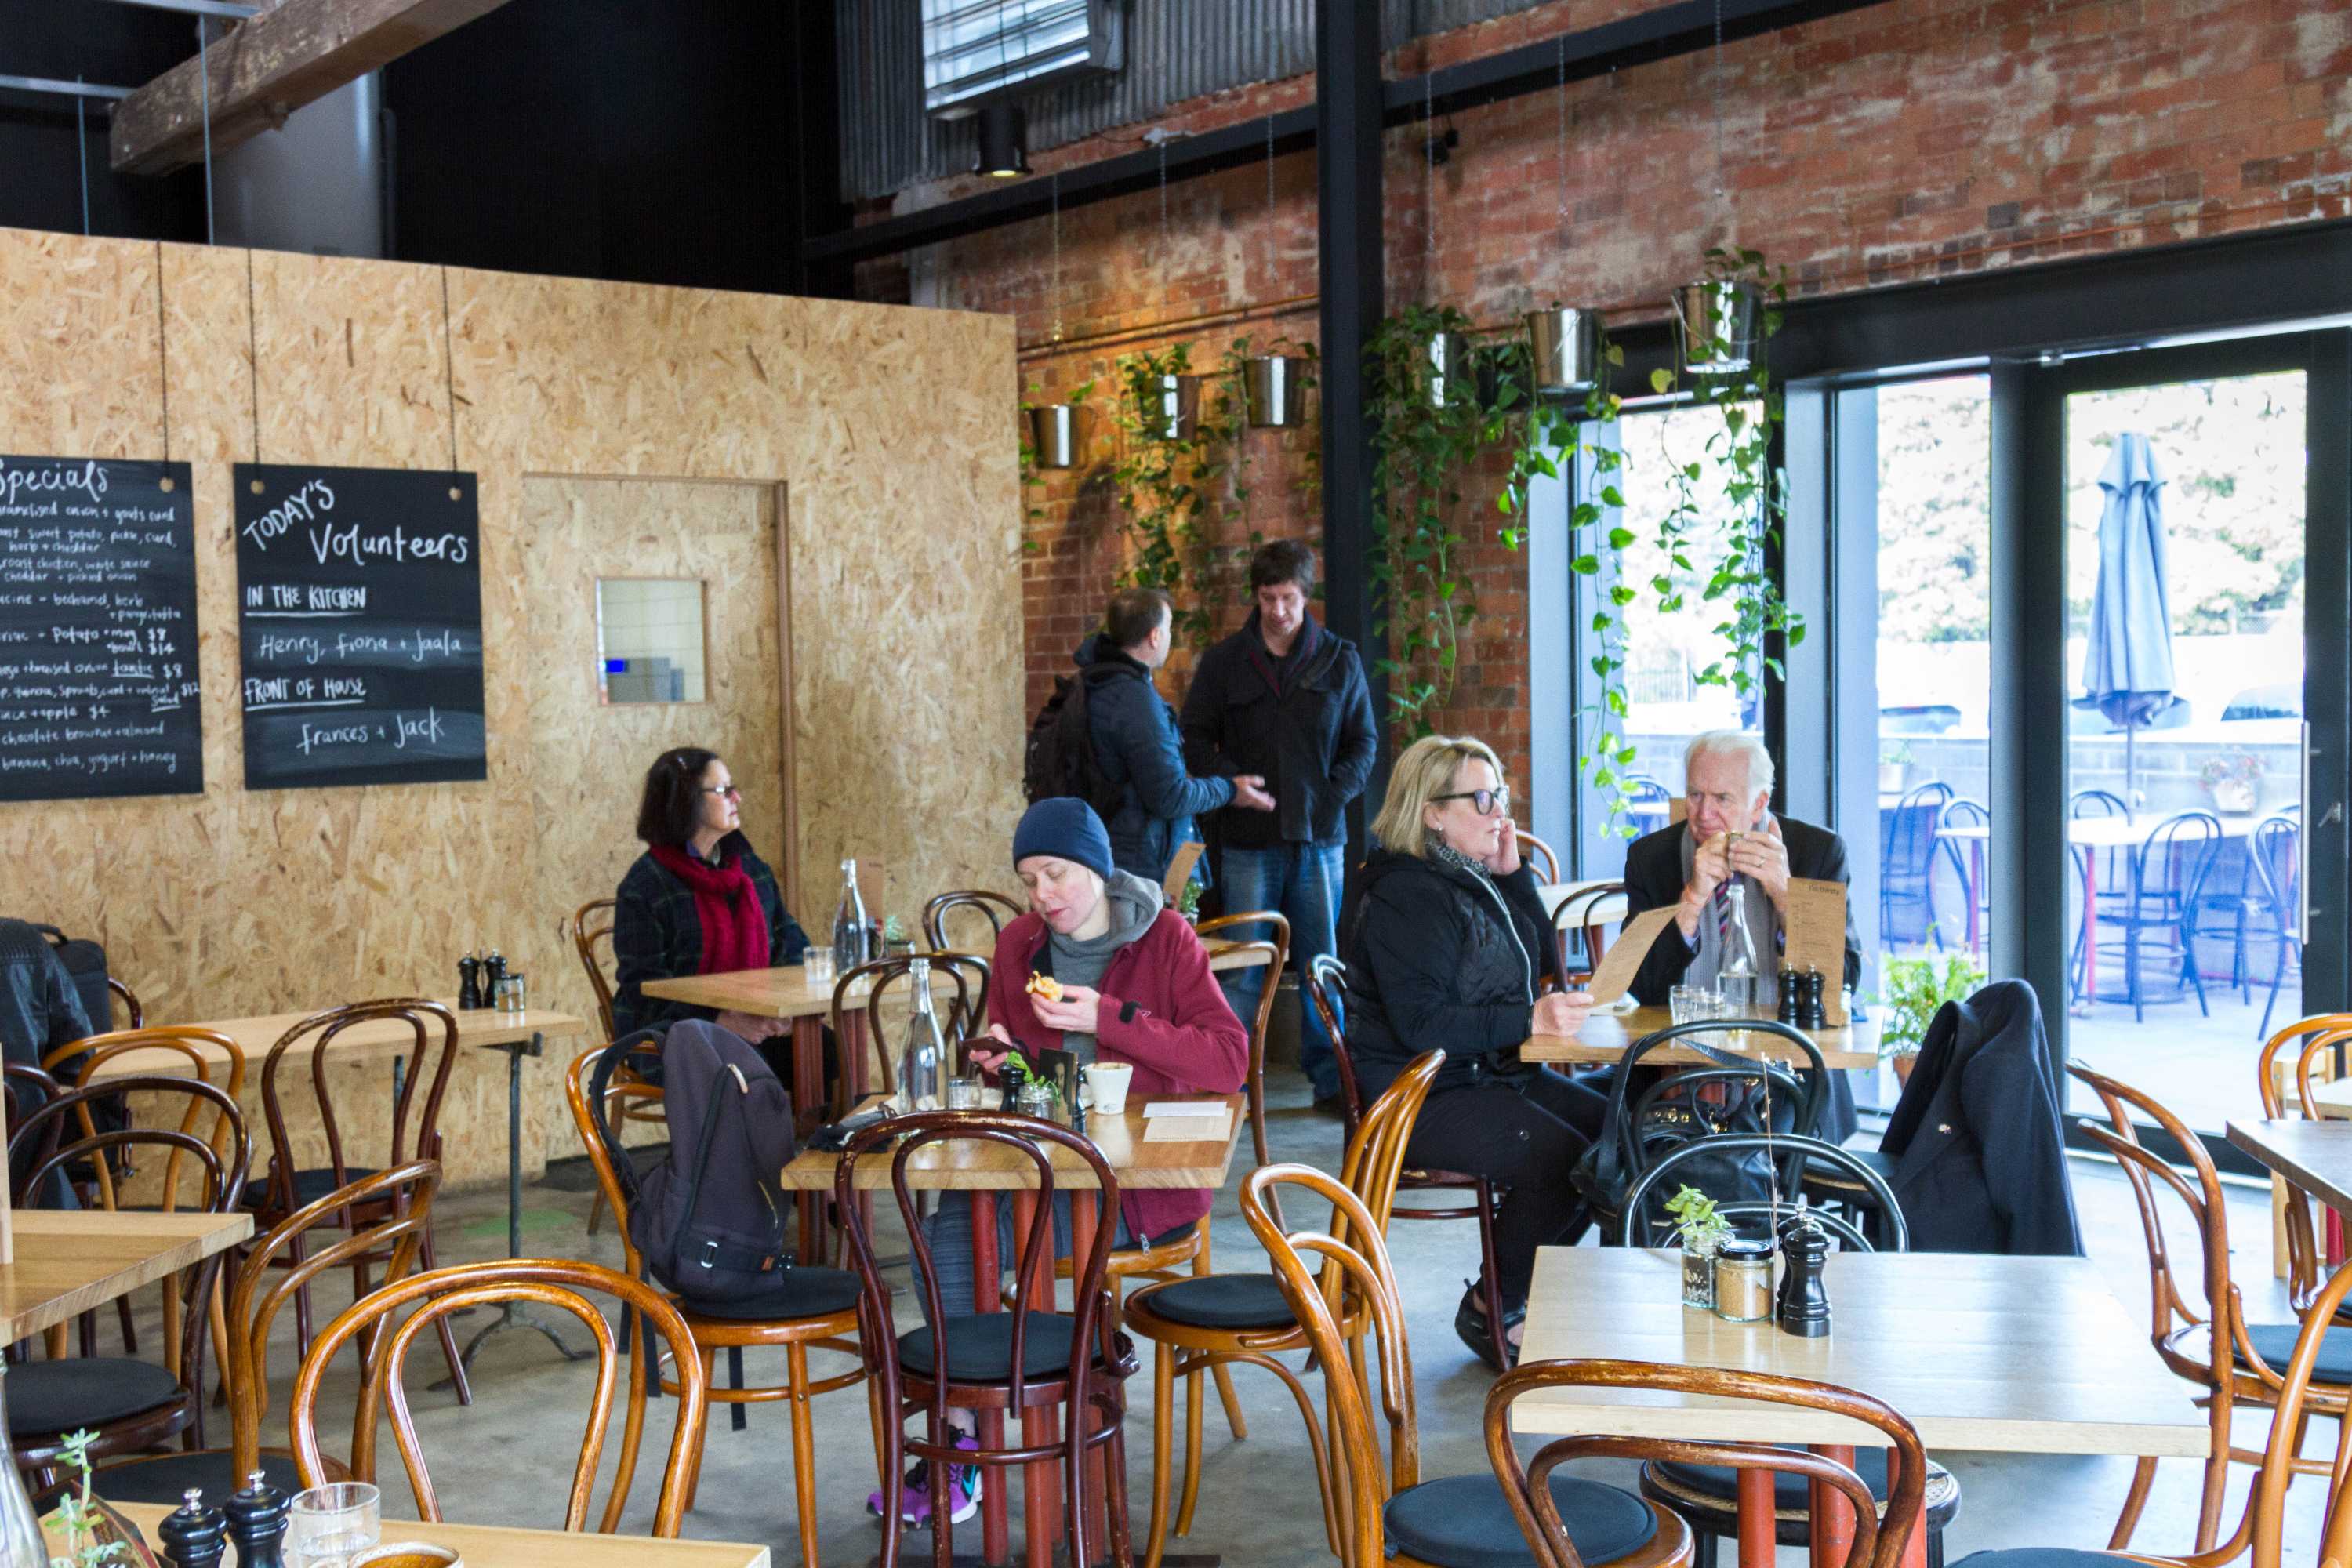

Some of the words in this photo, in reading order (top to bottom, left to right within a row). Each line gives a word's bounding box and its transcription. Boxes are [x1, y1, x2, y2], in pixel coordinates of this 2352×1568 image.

[0, 501, 57, 517] ramelised
[243, 479, 335, 550] TODAY'S
[309, 522, 468, 565] Volunteers
[247, 586, 263, 607] IN
[273, 585, 301, 608] THE
[309, 586, 365, 609] KITCHEN
[52, 626, 100, 644] Potato
[260, 633, 326, 664] Henry,
[245, 677, 291, 704] FRONT
[296, 678, 314, 700] OF
[324, 677, 367, 699] HOUSE
[39, 705, 77, 720] apple
[89, 705, 111, 720] $4
